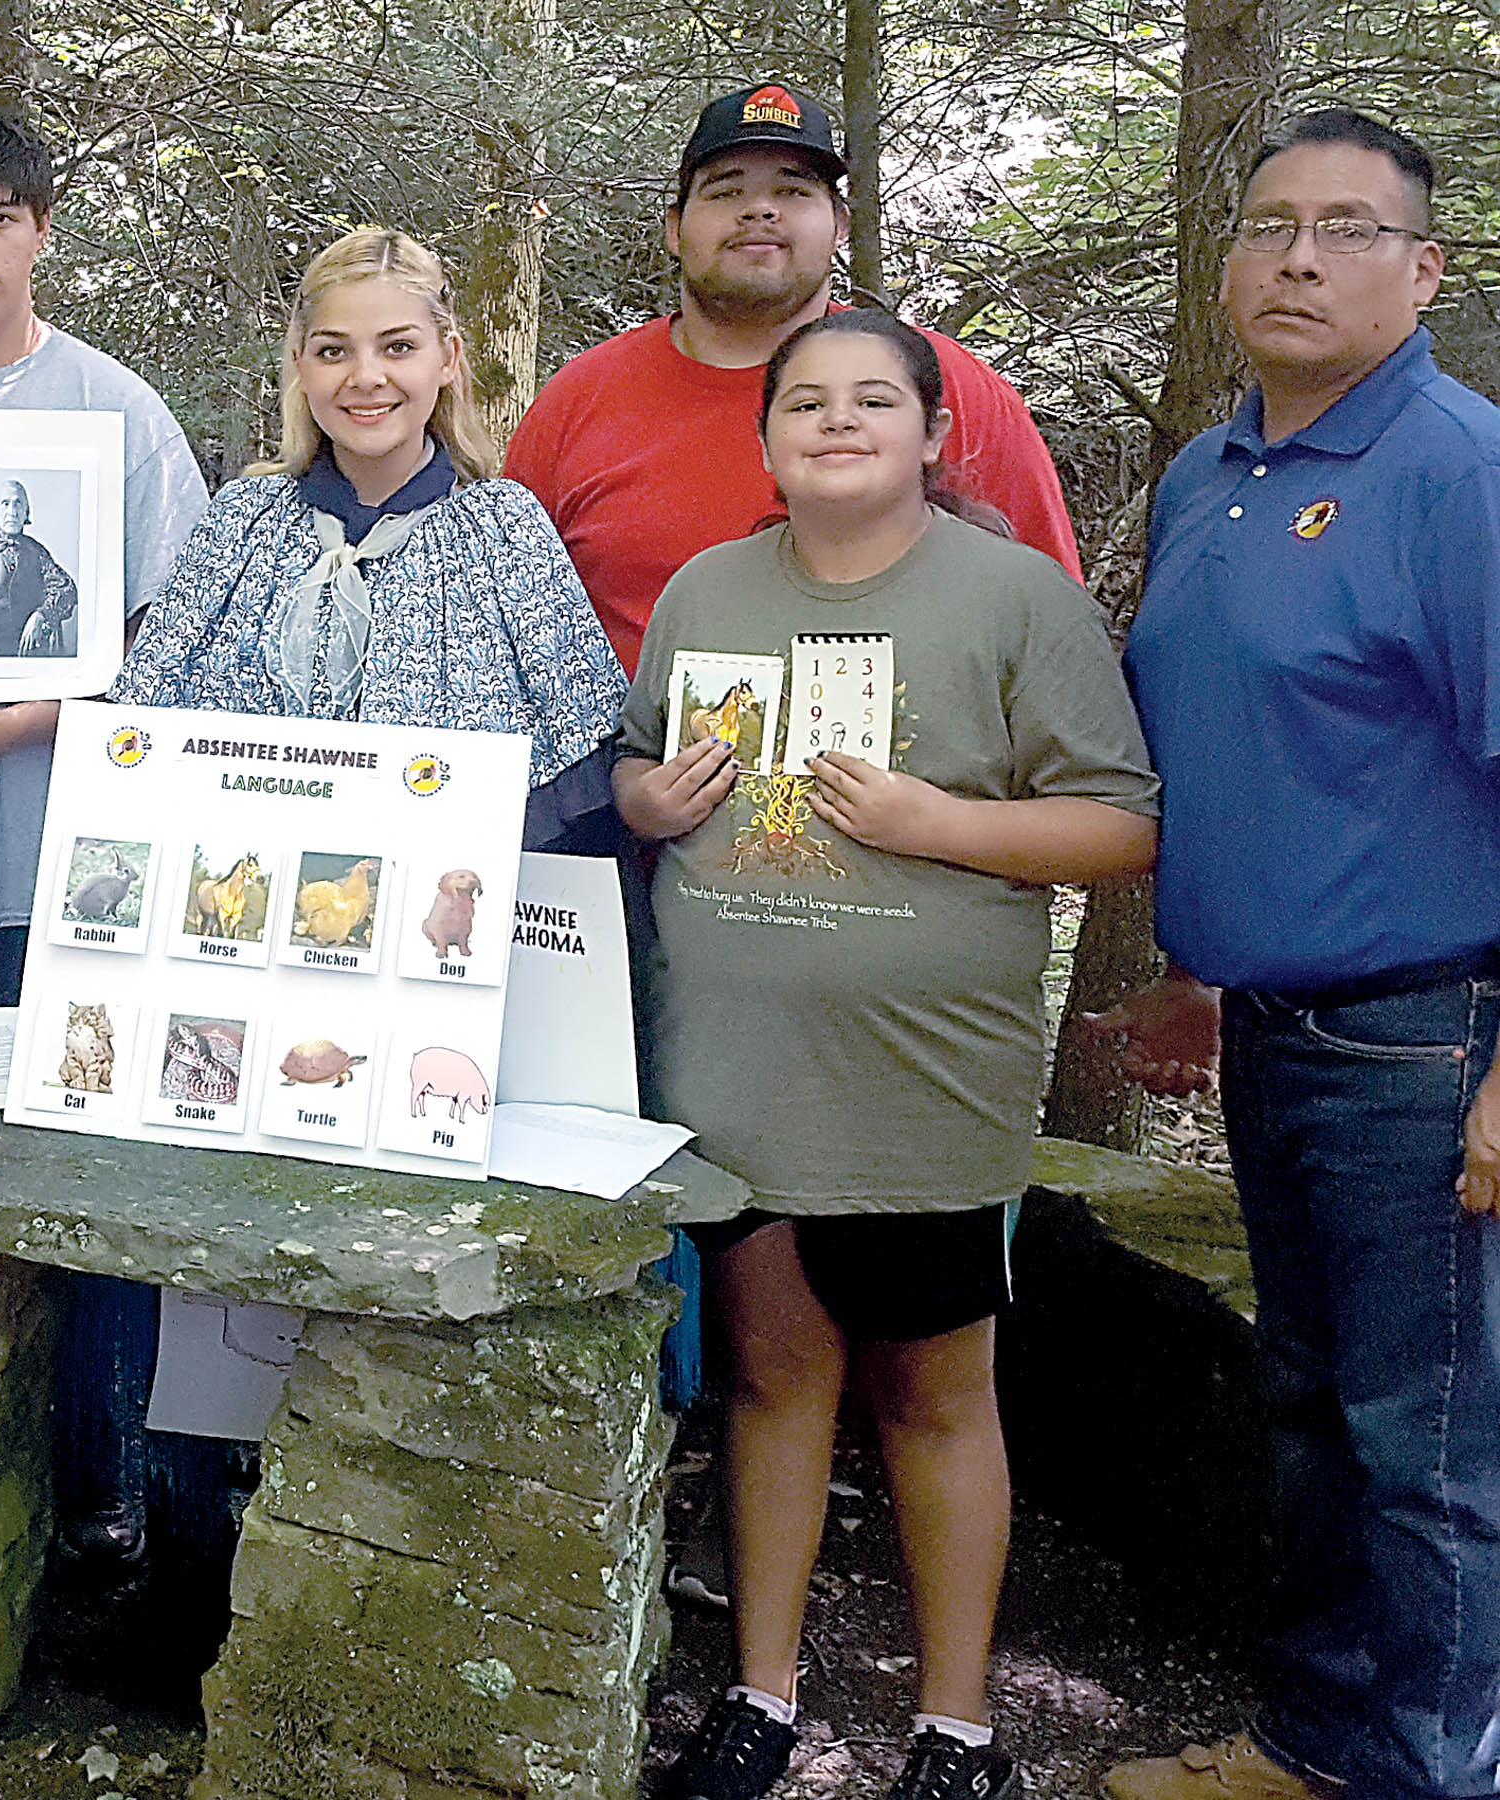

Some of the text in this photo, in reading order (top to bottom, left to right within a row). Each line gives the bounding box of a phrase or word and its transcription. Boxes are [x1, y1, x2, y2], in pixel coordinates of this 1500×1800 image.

[743, 104, 801, 126] SUNBELT
[812, 657, 873, 677] 1 2 3
[862, 681, 875, 700] 4
[811, 705, 874, 725] 9 5
[809, 728, 821, 747] 8
[861, 731, 873, 749] 6
[182, 738, 378, 769] ABSENTEE SHAWNEE
[221, 773, 334, 799] LANGUAGE
[750, 889, 775, 908] They
[776, 891, 806, 908] didn't
[809, 893, 838, 912] know
[839, 904, 855, 913] we
[857, 905, 881, 916] were
[716, 903, 838, 930] Absentee Shawnee Tribe
[74, 927, 116, 943] Rabbit
[200, 940, 238, 958] Horse
[303, 949, 359, 968] Chicken
[440, 962, 466, 978] Dog
[64, 1093, 86, 1109] Cat
[175, 1104, 216, 1121] Snake
[297, 1109, 337, 1127] Turtle
[432, 1129, 455, 1148] Pig
